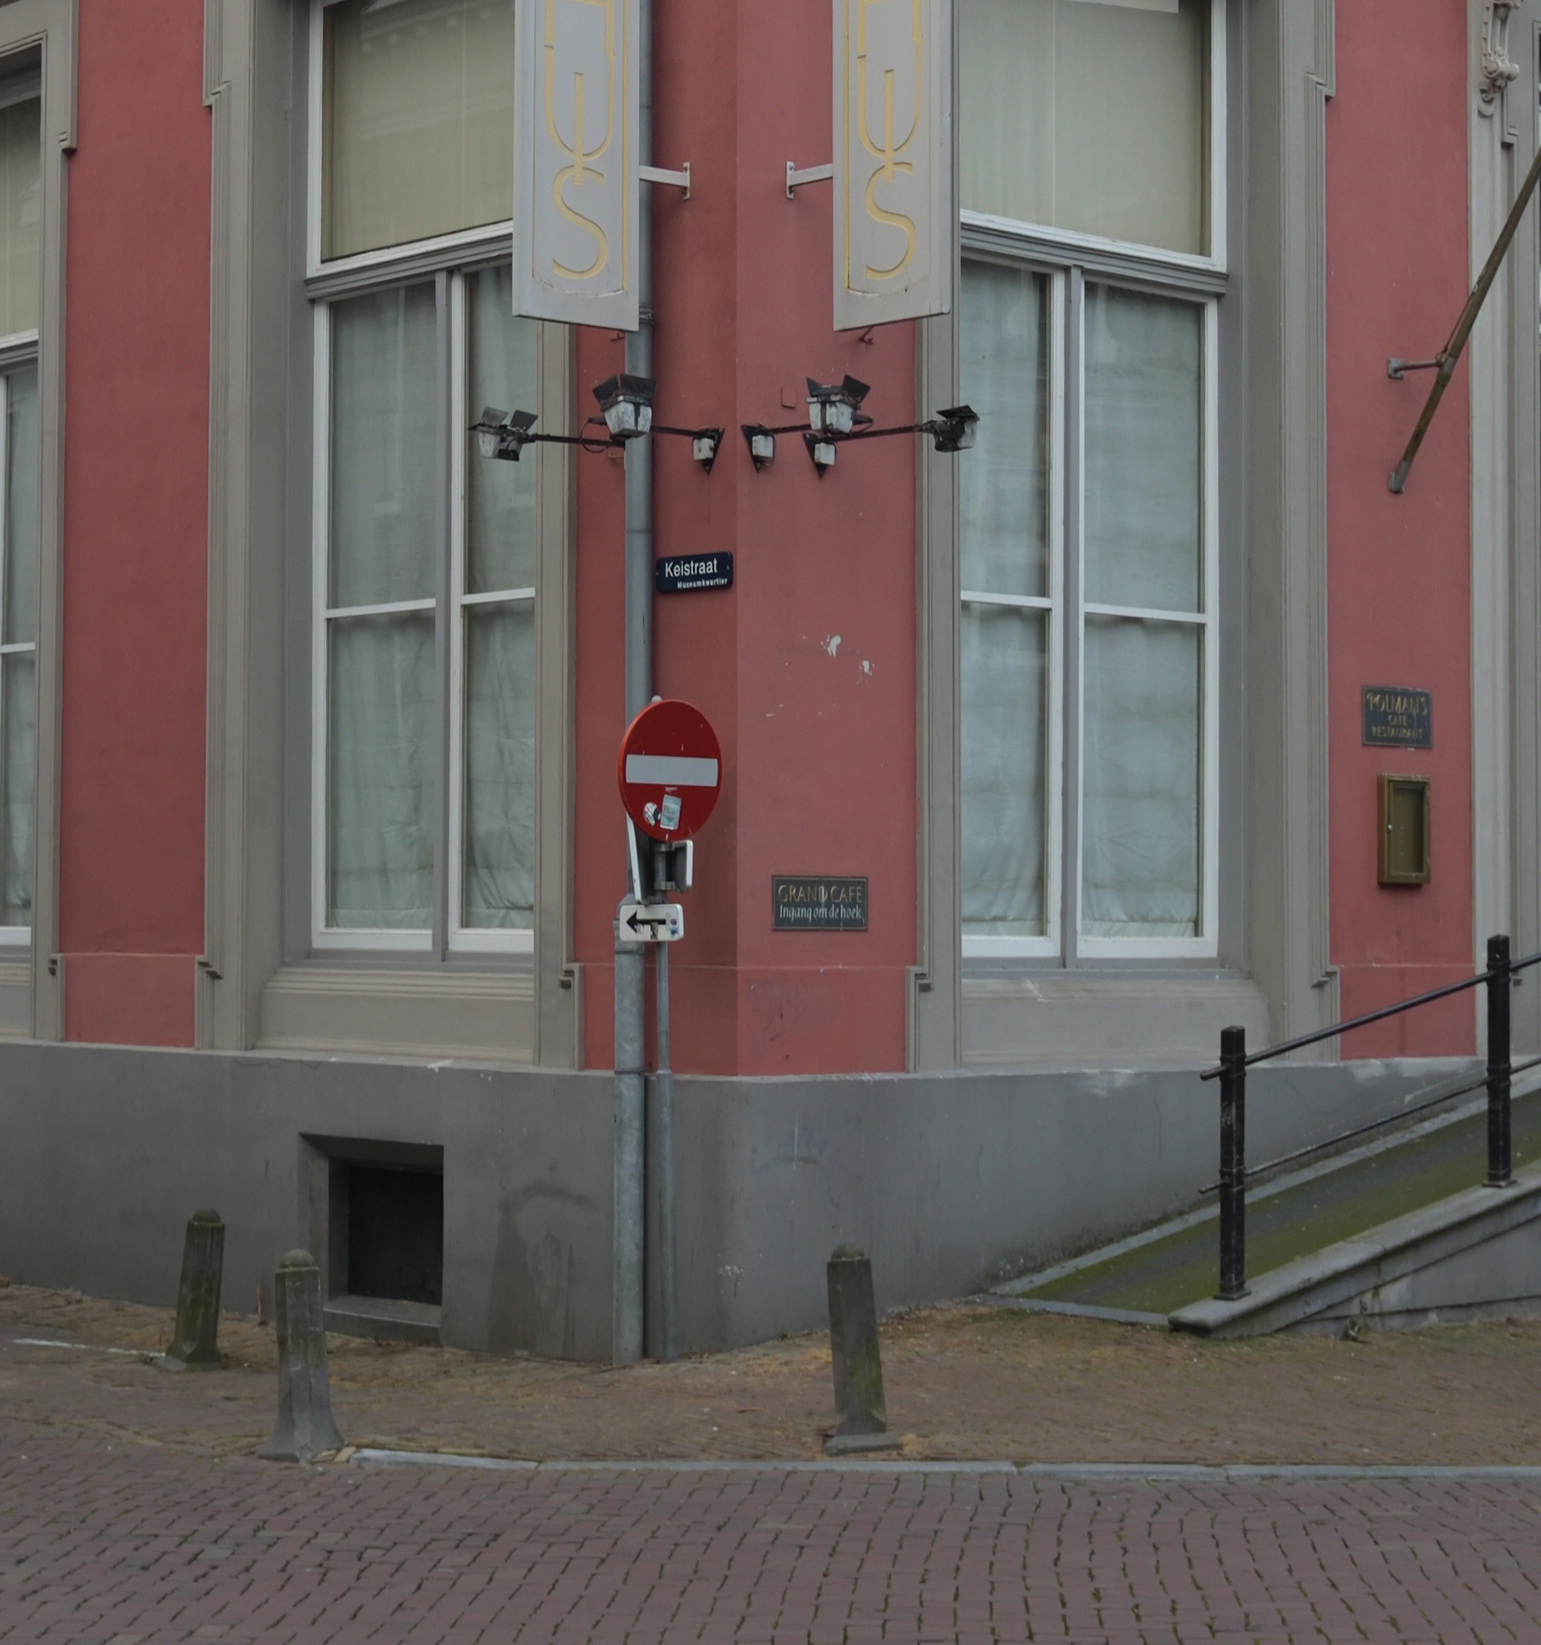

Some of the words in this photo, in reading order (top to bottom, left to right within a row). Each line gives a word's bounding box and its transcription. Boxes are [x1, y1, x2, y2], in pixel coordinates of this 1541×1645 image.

[664, 557, 718, 578] Keistraat
[676, 577, 728, 589] Museumkwartier
[778, 884, 828, 903] GRAND
[830, 885, 863, 903] CAFE
[779, 904, 812, 923] Ingang
[813, 906, 828, 919] om
[828, 904, 839, 919] de
[840, 904, 862, 919] hoek
